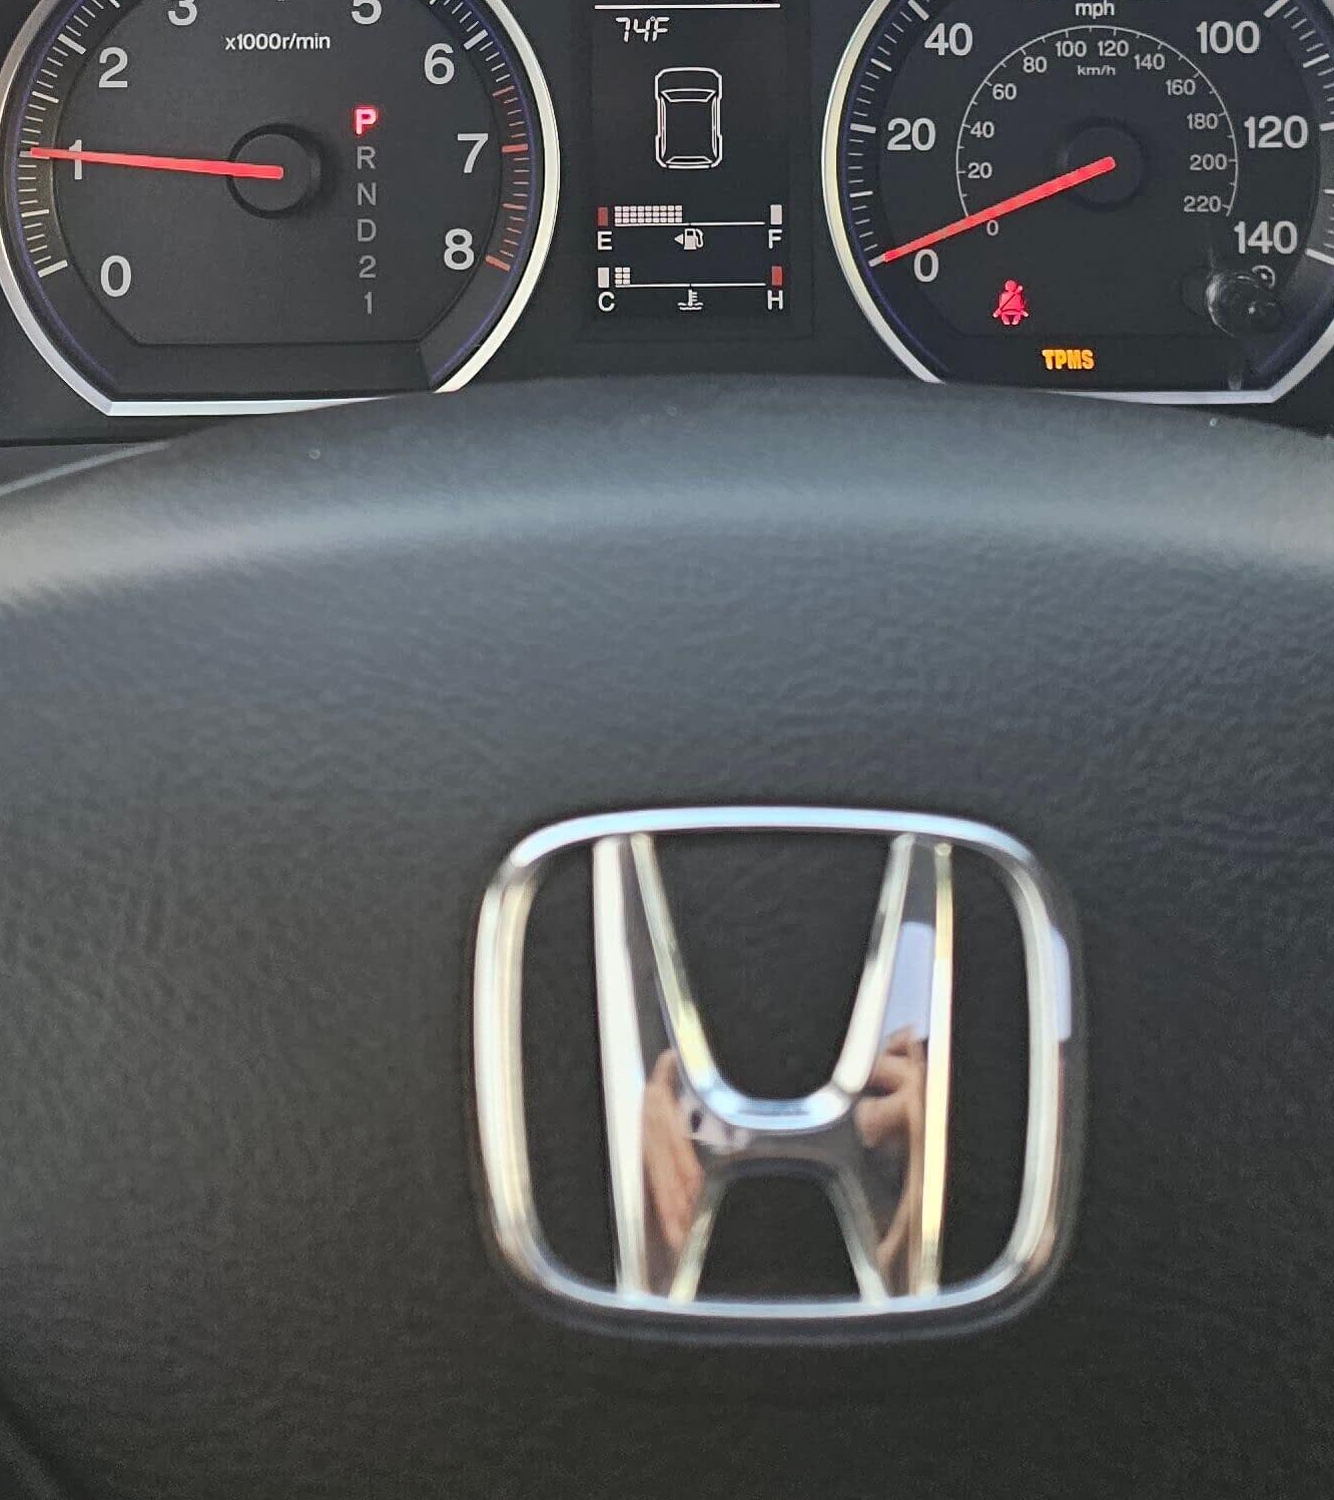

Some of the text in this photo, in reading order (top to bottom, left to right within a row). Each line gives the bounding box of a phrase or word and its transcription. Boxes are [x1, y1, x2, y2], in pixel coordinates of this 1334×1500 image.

[1076, 0, 1114, 19] mph
[226, 33, 330, 50] x1000r/min
[925, 23, 972, 55] 40
[1197, 21, 1259, 53] 100
[1056, 41, 1086, 57] 100
[1098, 40, 1129, 56] 120
[99, 47, 127, 87] 2
[425, 43, 454, 84] 6
[1023, 56, 1047, 73] 80
[1078, 65, 1115, 75] km/h
[1134, 53, 1165, 70] 140
[993, 83, 1016, 100] 60
[1166, 79, 1196, 95] 160
[355, 106, 378, 134] P
[970, 121, 994, 138] 40
[1187, 113, 1218, 129] 180
[887, 118, 935, 150] 20
[1244, 115, 1308, 148] 120
[70, 140, 83, 179] 1
[357, 146, 375, 169] R
[458, 133, 488, 173] 7
[1190, 154, 1227, 170] 200
[968, 162, 992, 178] 20
[358, 183, 376, 205] N
[1184, 196, 1221, 212] 220
[358, 219, 376, 241] D
[987, 220, 999, 236] 0
[1234, 221, 1297, 254] 140
[598, 231, 612, 250] E
[769, 229, 782, 248] F
[444, 229, 474, 270] 8
[359, 255, 376, 278] 2
[914, 249, 938, 282] 0
[101, 255, 131, 297] 0
[365, 292, 372, 314] 1
[599, 292, 614, 311] C
[768, 290, 783, 309] H
[1042, 349, 1094, 369] TPMS
